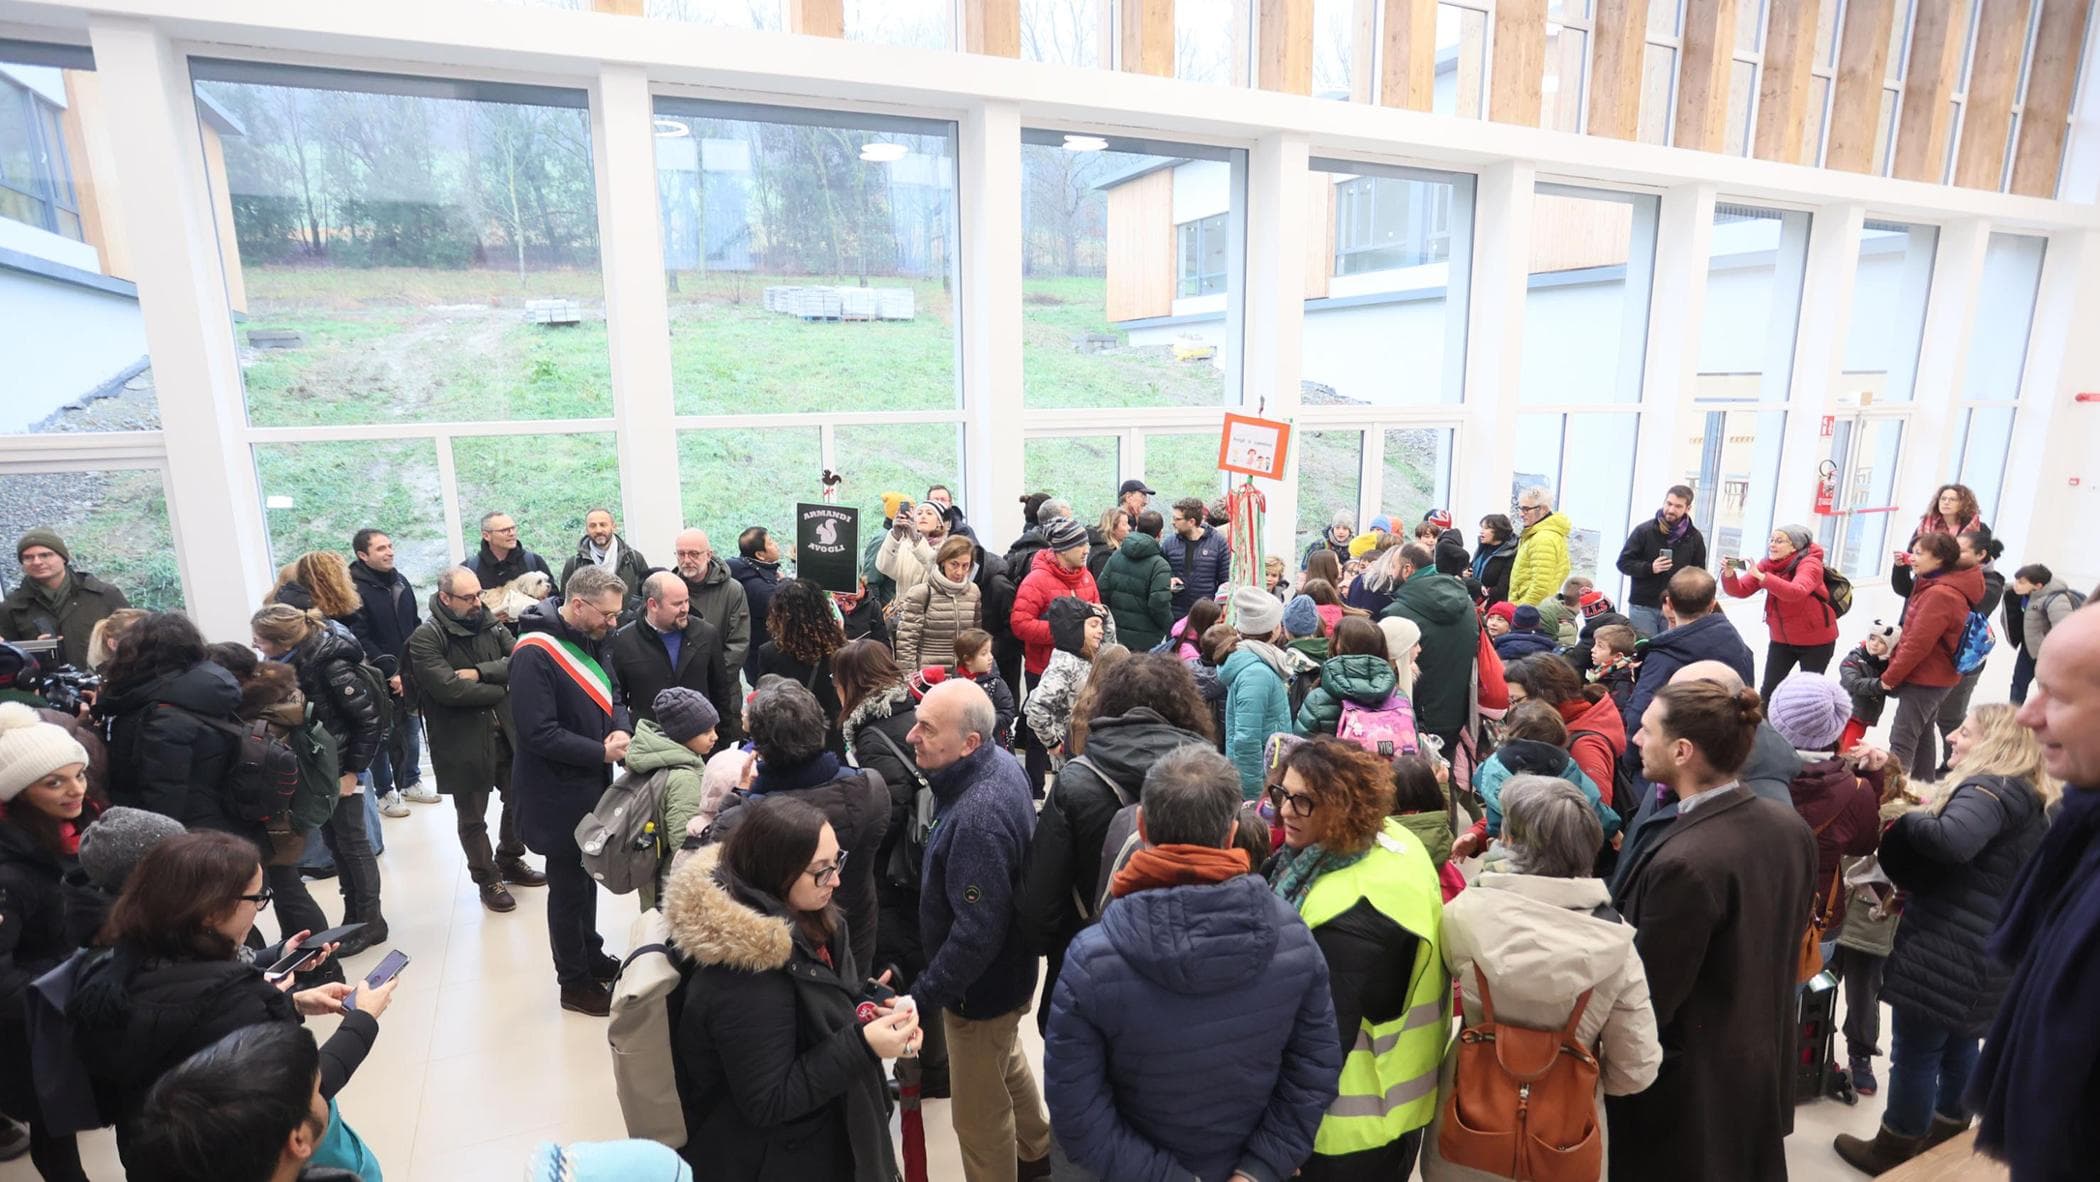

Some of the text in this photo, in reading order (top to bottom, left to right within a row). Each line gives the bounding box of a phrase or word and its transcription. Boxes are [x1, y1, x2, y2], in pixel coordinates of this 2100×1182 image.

[803, 510, 852, 523] ARMANDI
[808, 542, 846, 553] AVOGLI
[1583, 600, 1608, 618] LLS
